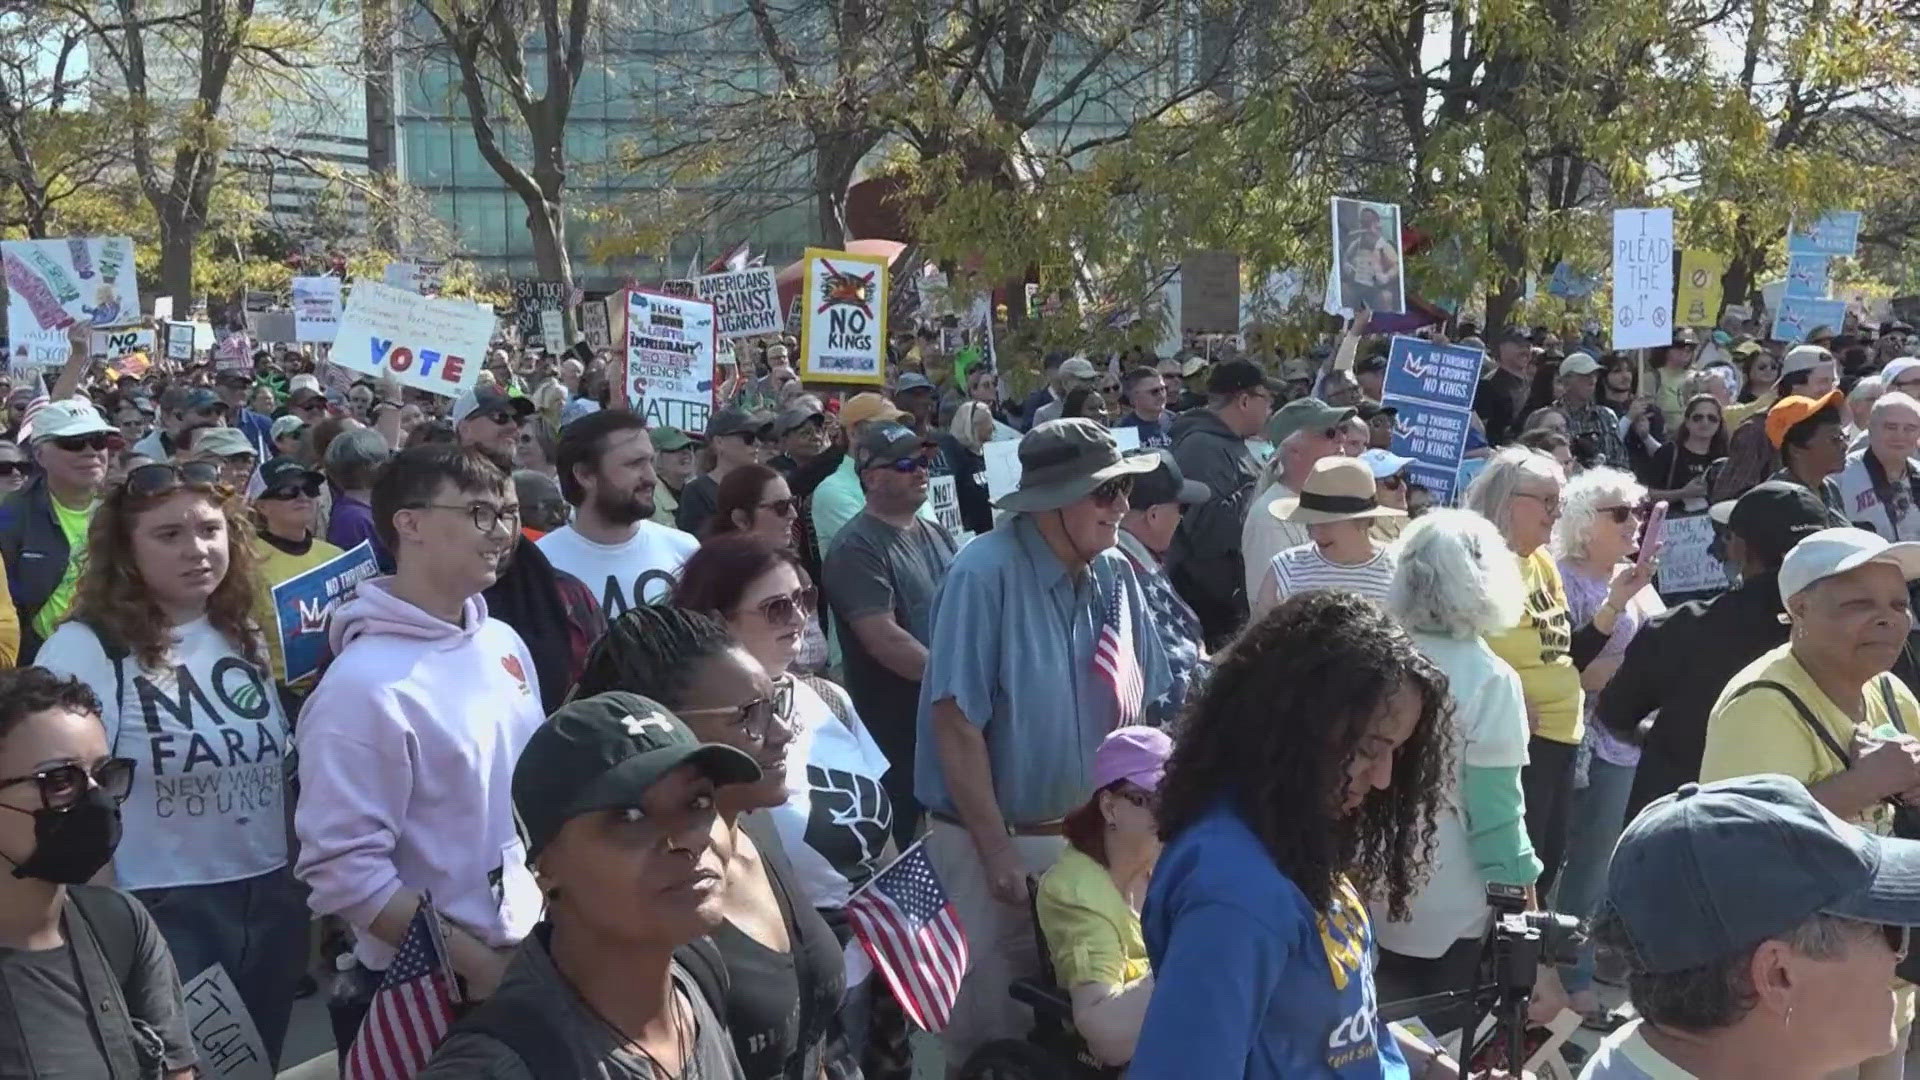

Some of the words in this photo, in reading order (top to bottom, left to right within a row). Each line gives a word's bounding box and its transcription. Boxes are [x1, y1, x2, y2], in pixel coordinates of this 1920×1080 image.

[1639, 211, 1648, 236] I
[1618, 237, 1670, 264] PLEAD
[518, 281, 533, 297] SO
[700, 271, 771, 295] AMERICANS
[1628, 265, 1660, 291] THE
[650, 303, 682, 316] BLACK
[714, 288, 773, 316] GAINST
[716, 310, 777, 333] LIGARCHY
[830, 308, 867, 334] NO
[108, 333, 138, 349] NO
[828, 333, 872, 351] KINGS
[370, 336, 466, 384] VOTE
[1429, 352, 1442, 364] NO
[629, 362, 682, 379] SCIENCE
[1425, 364, 1439, 377] NO
[1422, 378, 1437, 393] NO
[1438, 379, 1469, 400] KINGS.
[1416, 412, 1428, 424] NO
[1413, 425, 1426, 438] NO
[1410, 438, 1425, 454] NO
[1425, 439, 1457, 461] KINGS.
[933, 483, 953, 503] NOT
[326, 577, 339, 597] NO
[132, 656, 270, 733] MO
[155, 772, 222, 798] NEW
[156, 785, 282, 818] COUNC
[184, 979, 259, 1075] FIGHT
